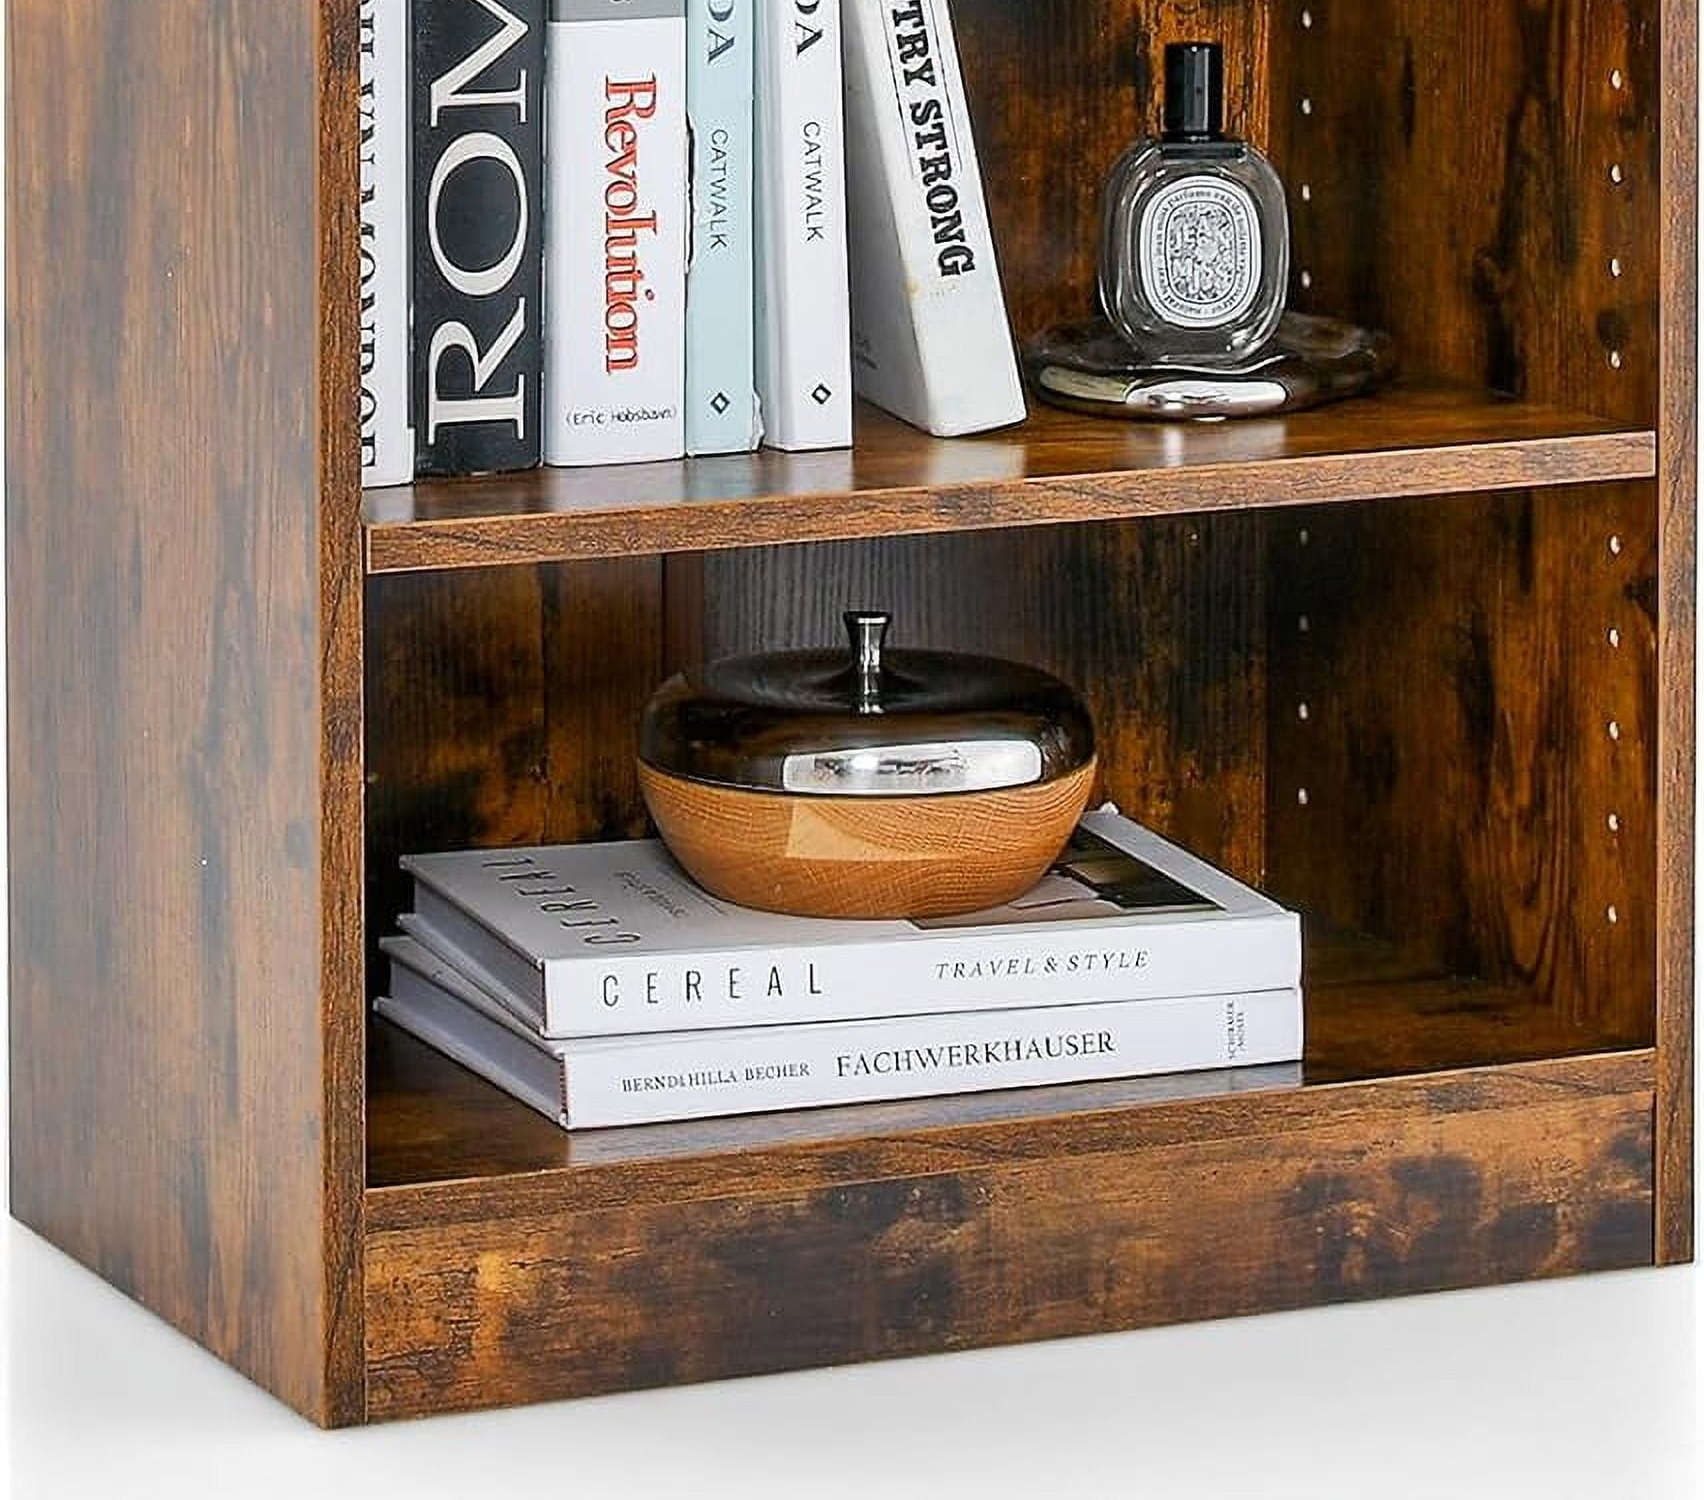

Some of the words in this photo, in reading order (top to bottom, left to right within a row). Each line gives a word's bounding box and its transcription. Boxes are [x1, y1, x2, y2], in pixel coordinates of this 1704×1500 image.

[605, 73, 660, 375] Revolution
[709, 128, 730, 251] CATWALK
[802, 120, 826, 243] CATWALK
[908, 98, 976, 278] STRONG
[603, 963, 823, 1007] CEREAL
[936, 957, 1034, 979] TRAVEL
[1043, 956, 1058, 974] &
[1067, 951, 1149, 972] STYLE
[745, 1062, 811, 1082] BECHER
